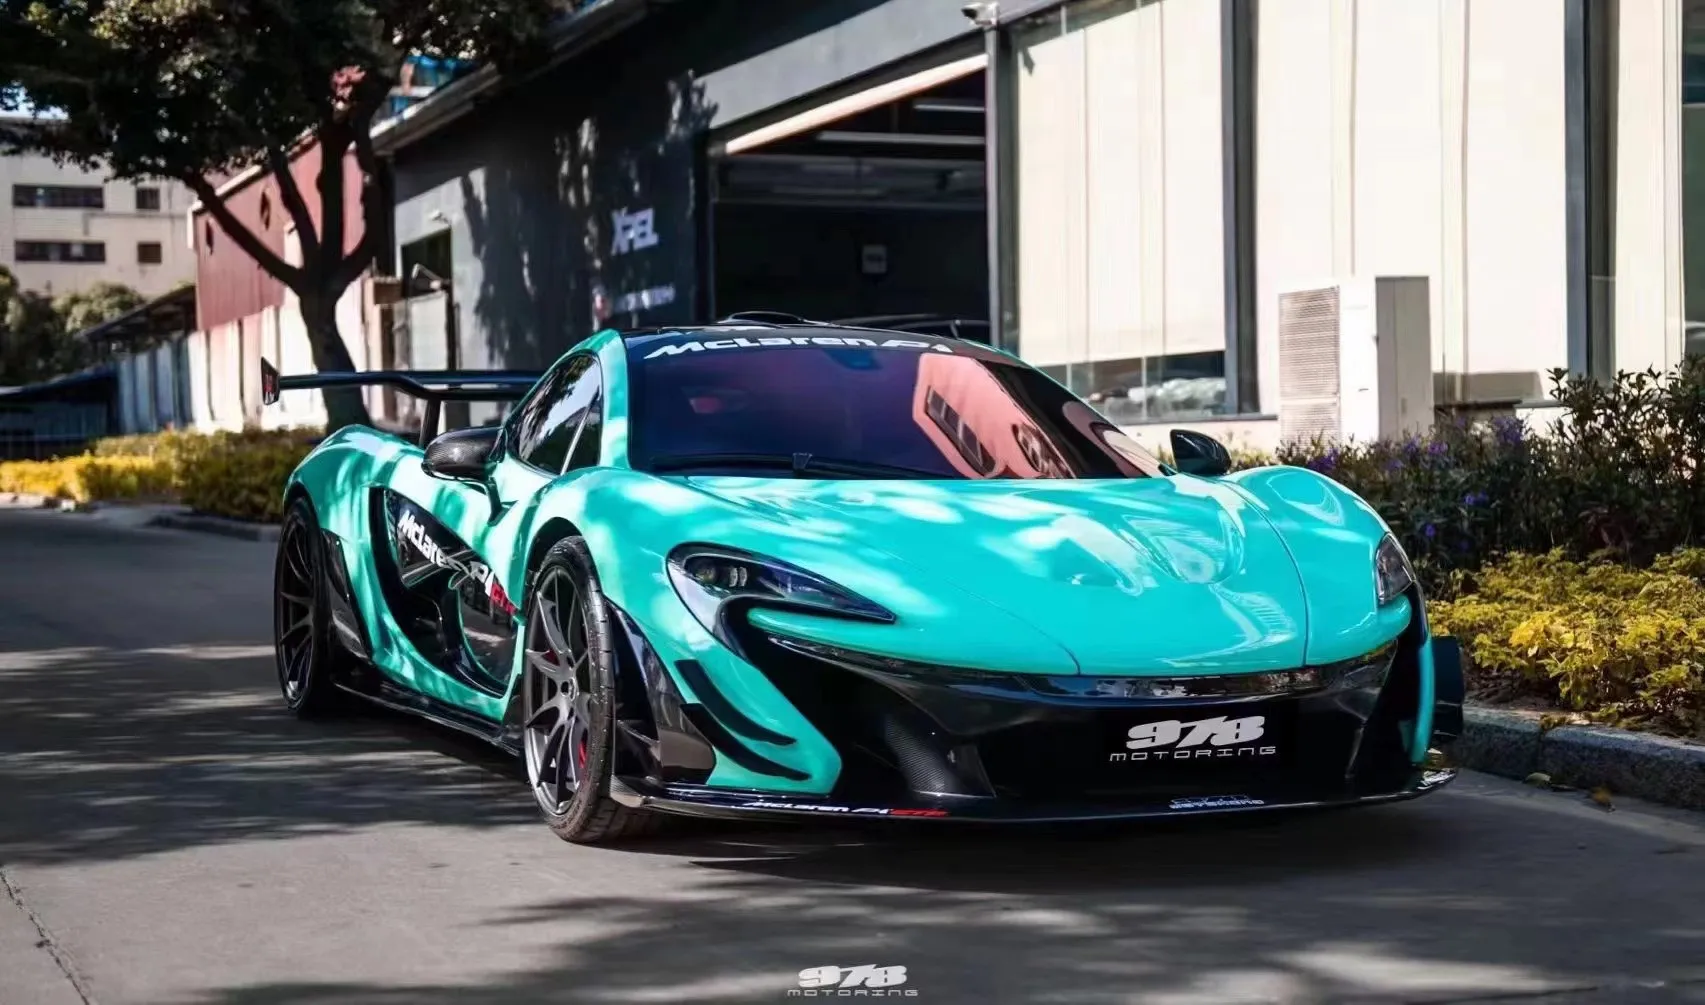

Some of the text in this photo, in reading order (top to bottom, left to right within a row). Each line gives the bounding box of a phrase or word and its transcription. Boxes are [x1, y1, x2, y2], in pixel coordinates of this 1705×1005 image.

[611, 207, 659, 256] XPEL
[643, 337, 872, 359] McLaren
[1126, 715, 1265, 750] 978
[1109, 746, 1276, 762] MOTORING
